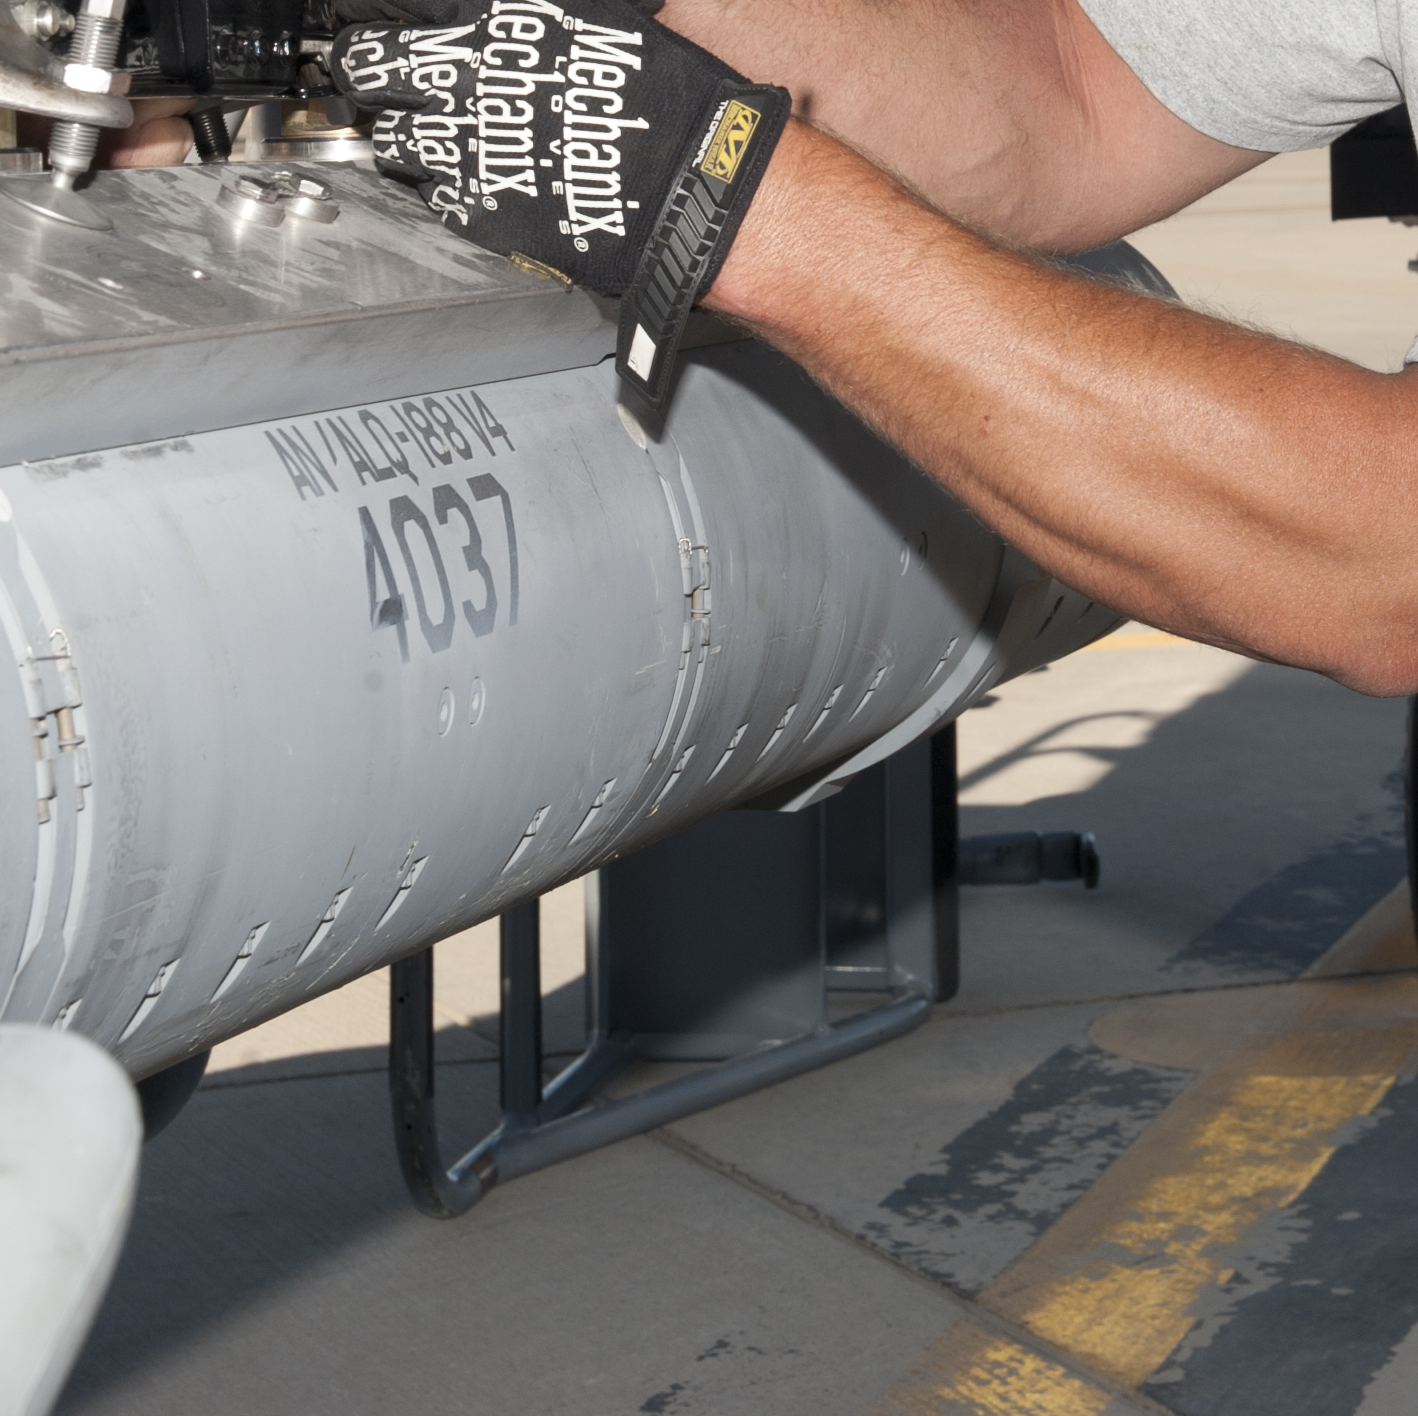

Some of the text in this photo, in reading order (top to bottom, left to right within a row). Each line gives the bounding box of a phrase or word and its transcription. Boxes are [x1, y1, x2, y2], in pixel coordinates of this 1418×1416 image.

[549, 15, 574, 235] GLOVES
[713, 100, 729, 121] THE
[445, 390, 516, 457] V4
[358, 472, 519, 665] 4037
